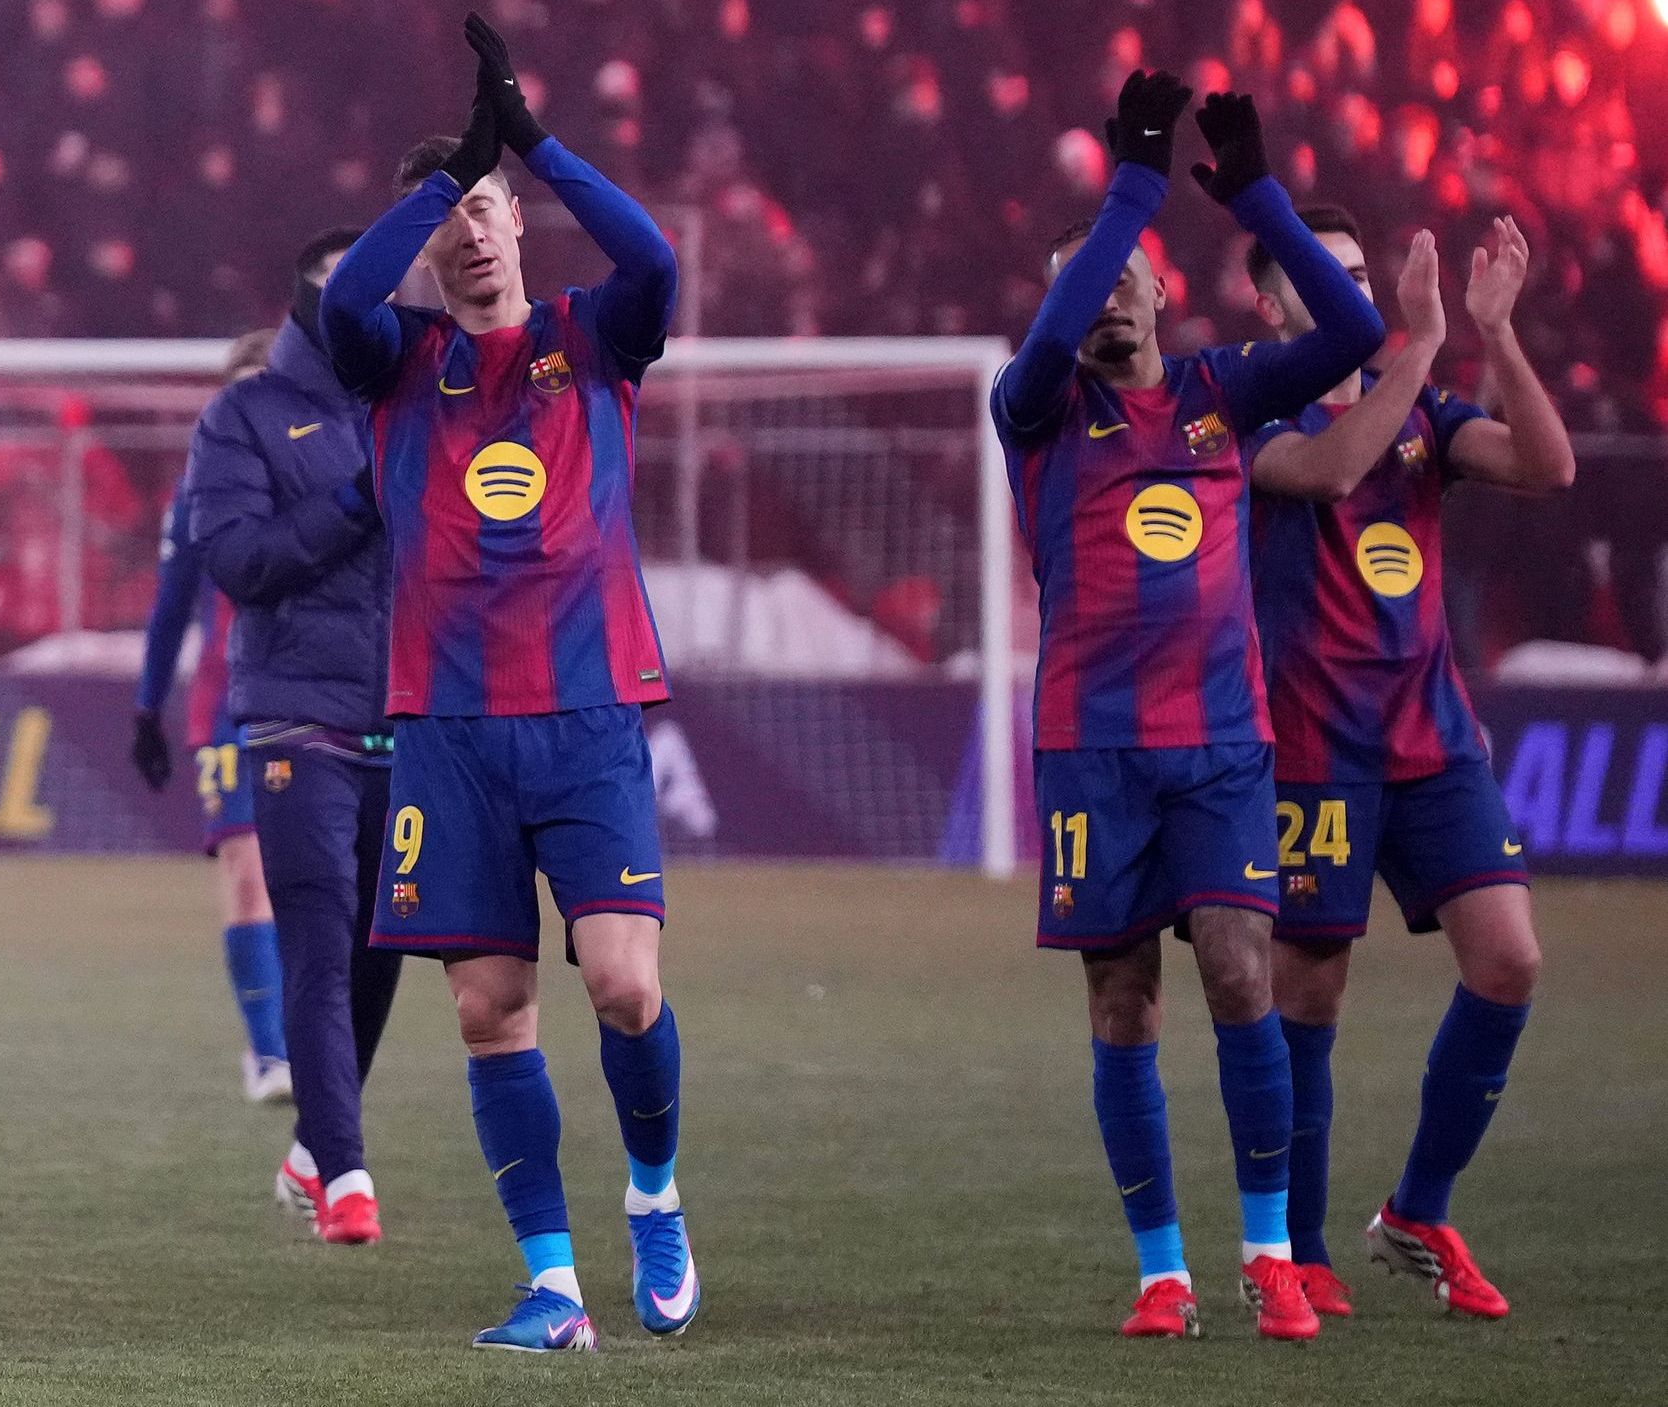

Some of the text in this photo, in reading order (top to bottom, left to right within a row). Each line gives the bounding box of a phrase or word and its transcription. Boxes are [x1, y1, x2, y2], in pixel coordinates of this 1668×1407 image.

[393, 805, 424, 874] 9
[1051, 810, 1088, 879] 11
[1275, 799, 1351, 867] 24
